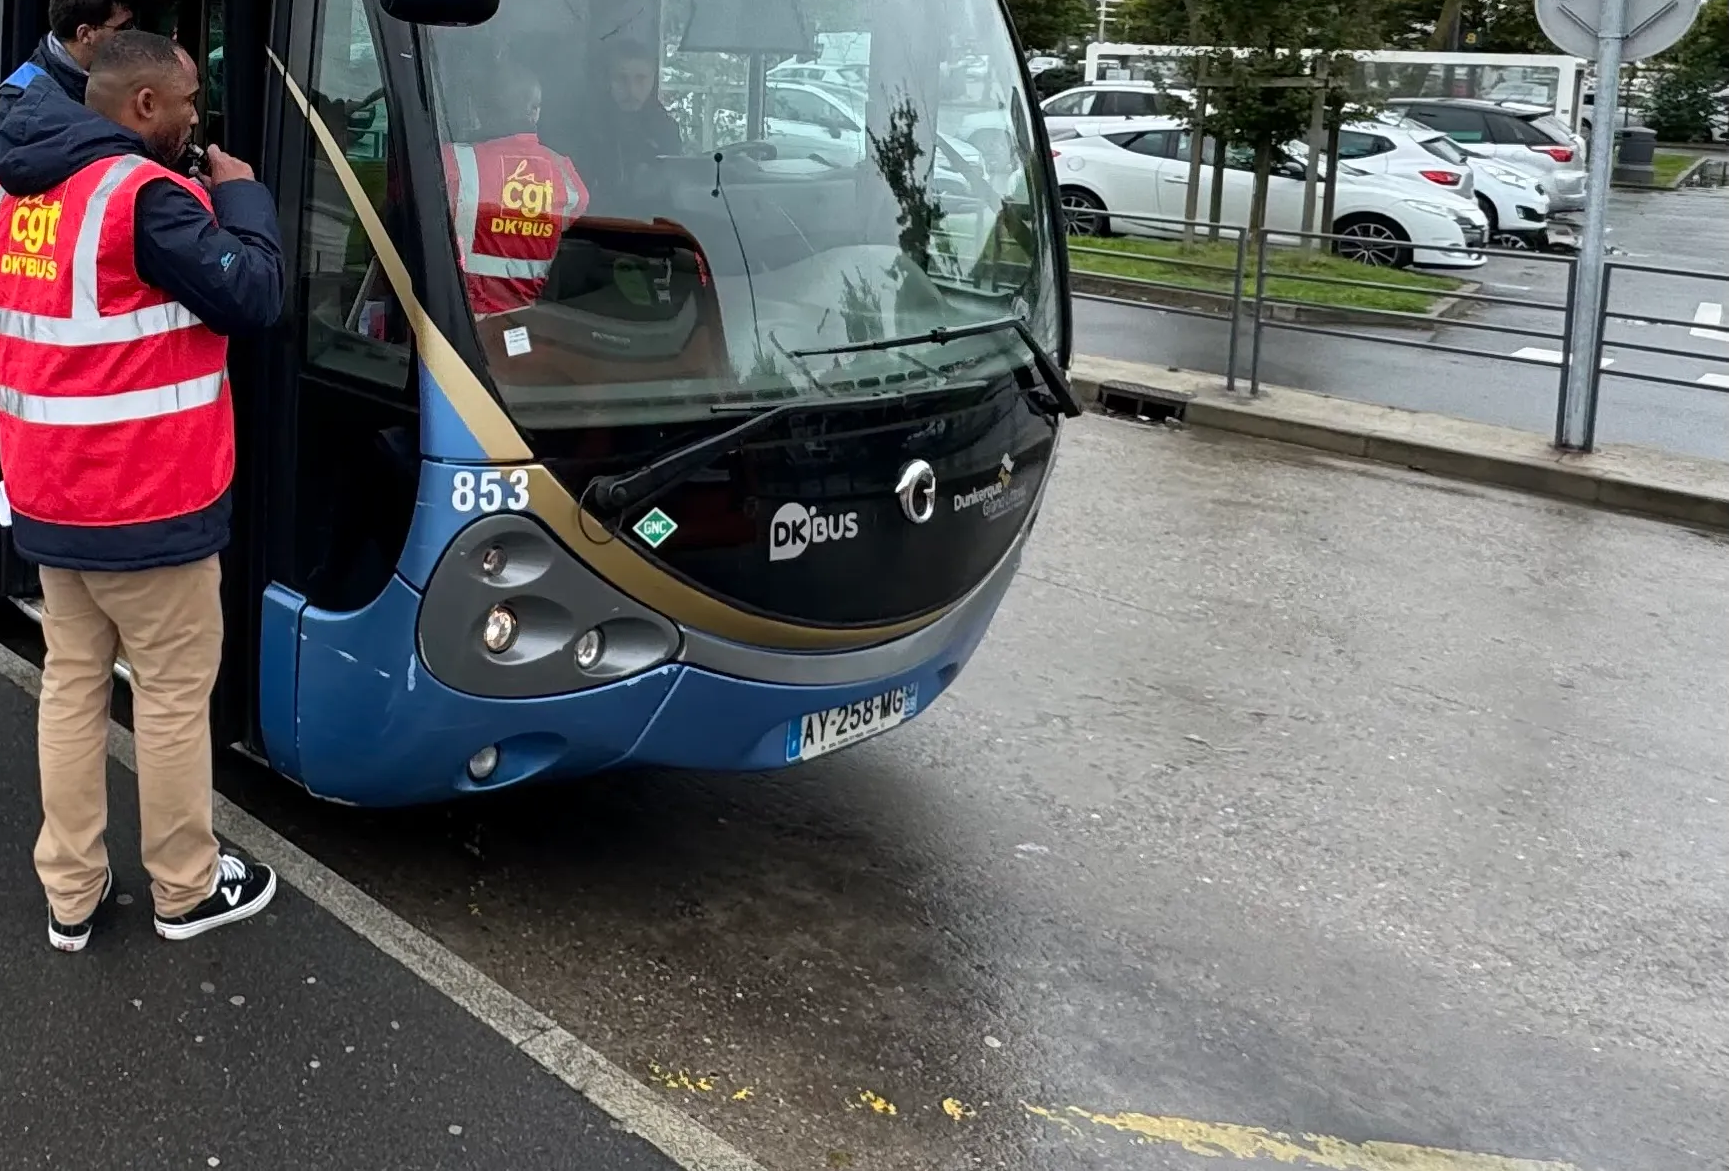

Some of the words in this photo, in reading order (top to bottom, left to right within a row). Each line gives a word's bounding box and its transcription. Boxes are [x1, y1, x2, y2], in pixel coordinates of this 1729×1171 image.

[502, 180, 554, 218] cgt
[12, 200, 61, 253] cgt
[491, 217, 554, 237] DK'BUS
[1, 254, 57, 281] DK'BUS
[452, 470, 530, 512] 853
[954, 481, 1003, 512] Dunkerque
[643, 521, 668, 534] GNC
[803, 687, 904, 749] AY-258-MG
